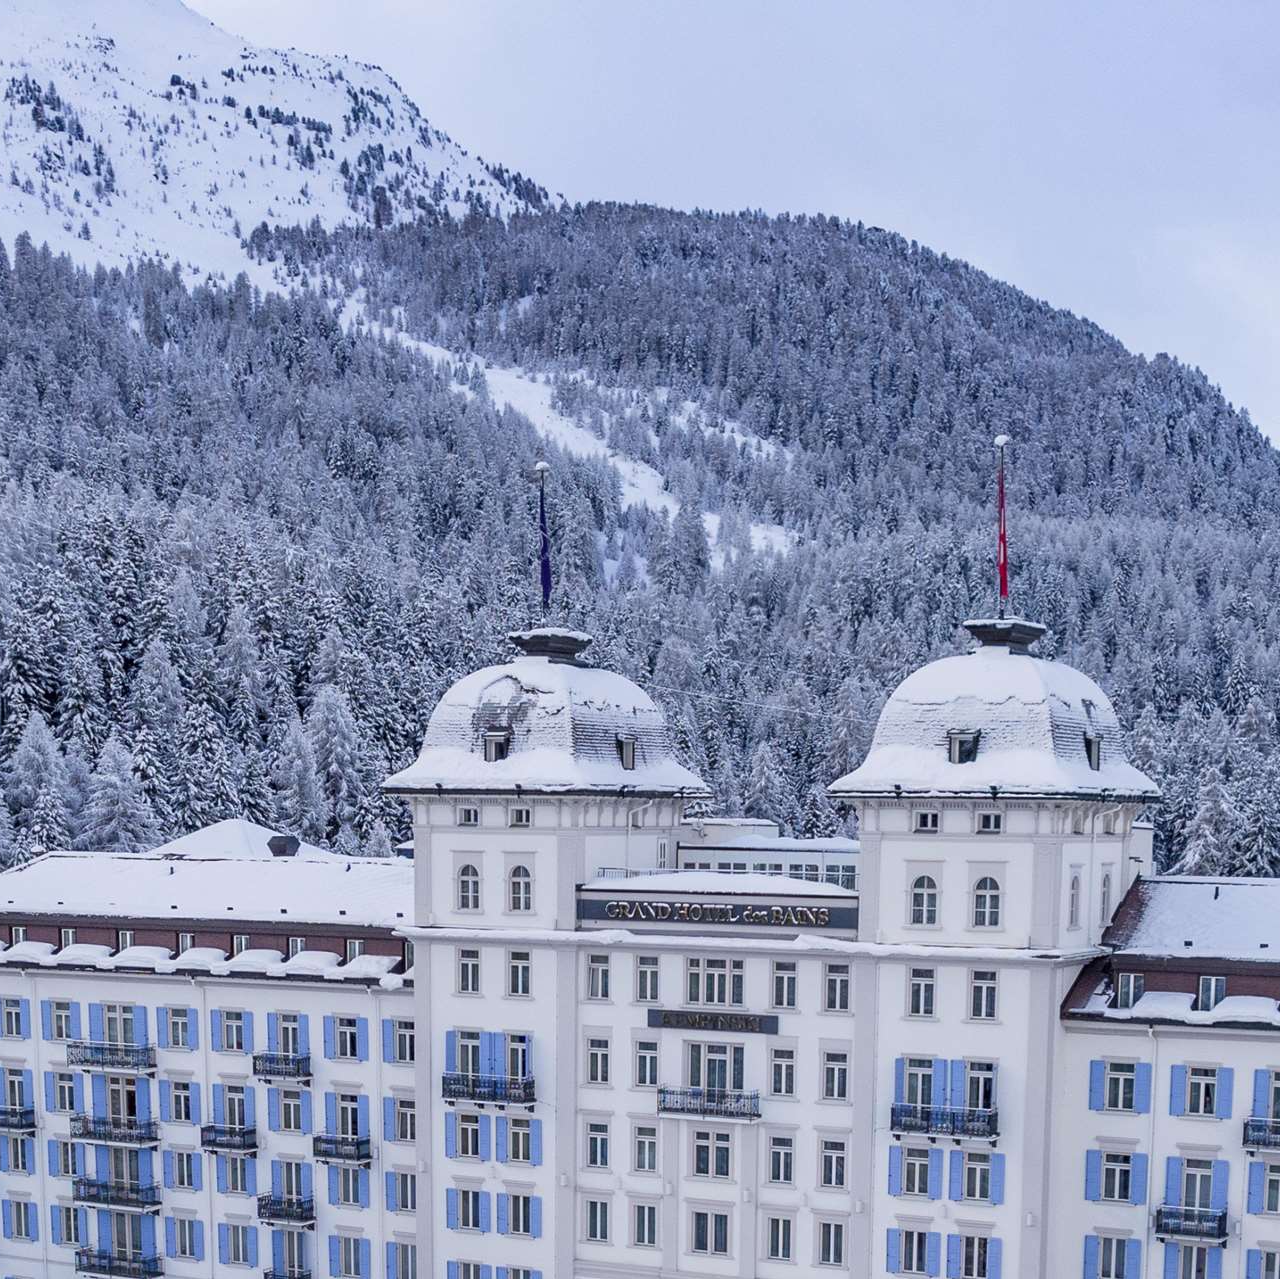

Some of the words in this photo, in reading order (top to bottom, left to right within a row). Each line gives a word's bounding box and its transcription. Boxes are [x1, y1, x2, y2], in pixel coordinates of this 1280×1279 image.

[605, 901, 671, 919] GRAND
[673, 903, 739, 922] HOTEL
[743, 906, 768, 922] des
[771, 906, 829, 925] BAINS
